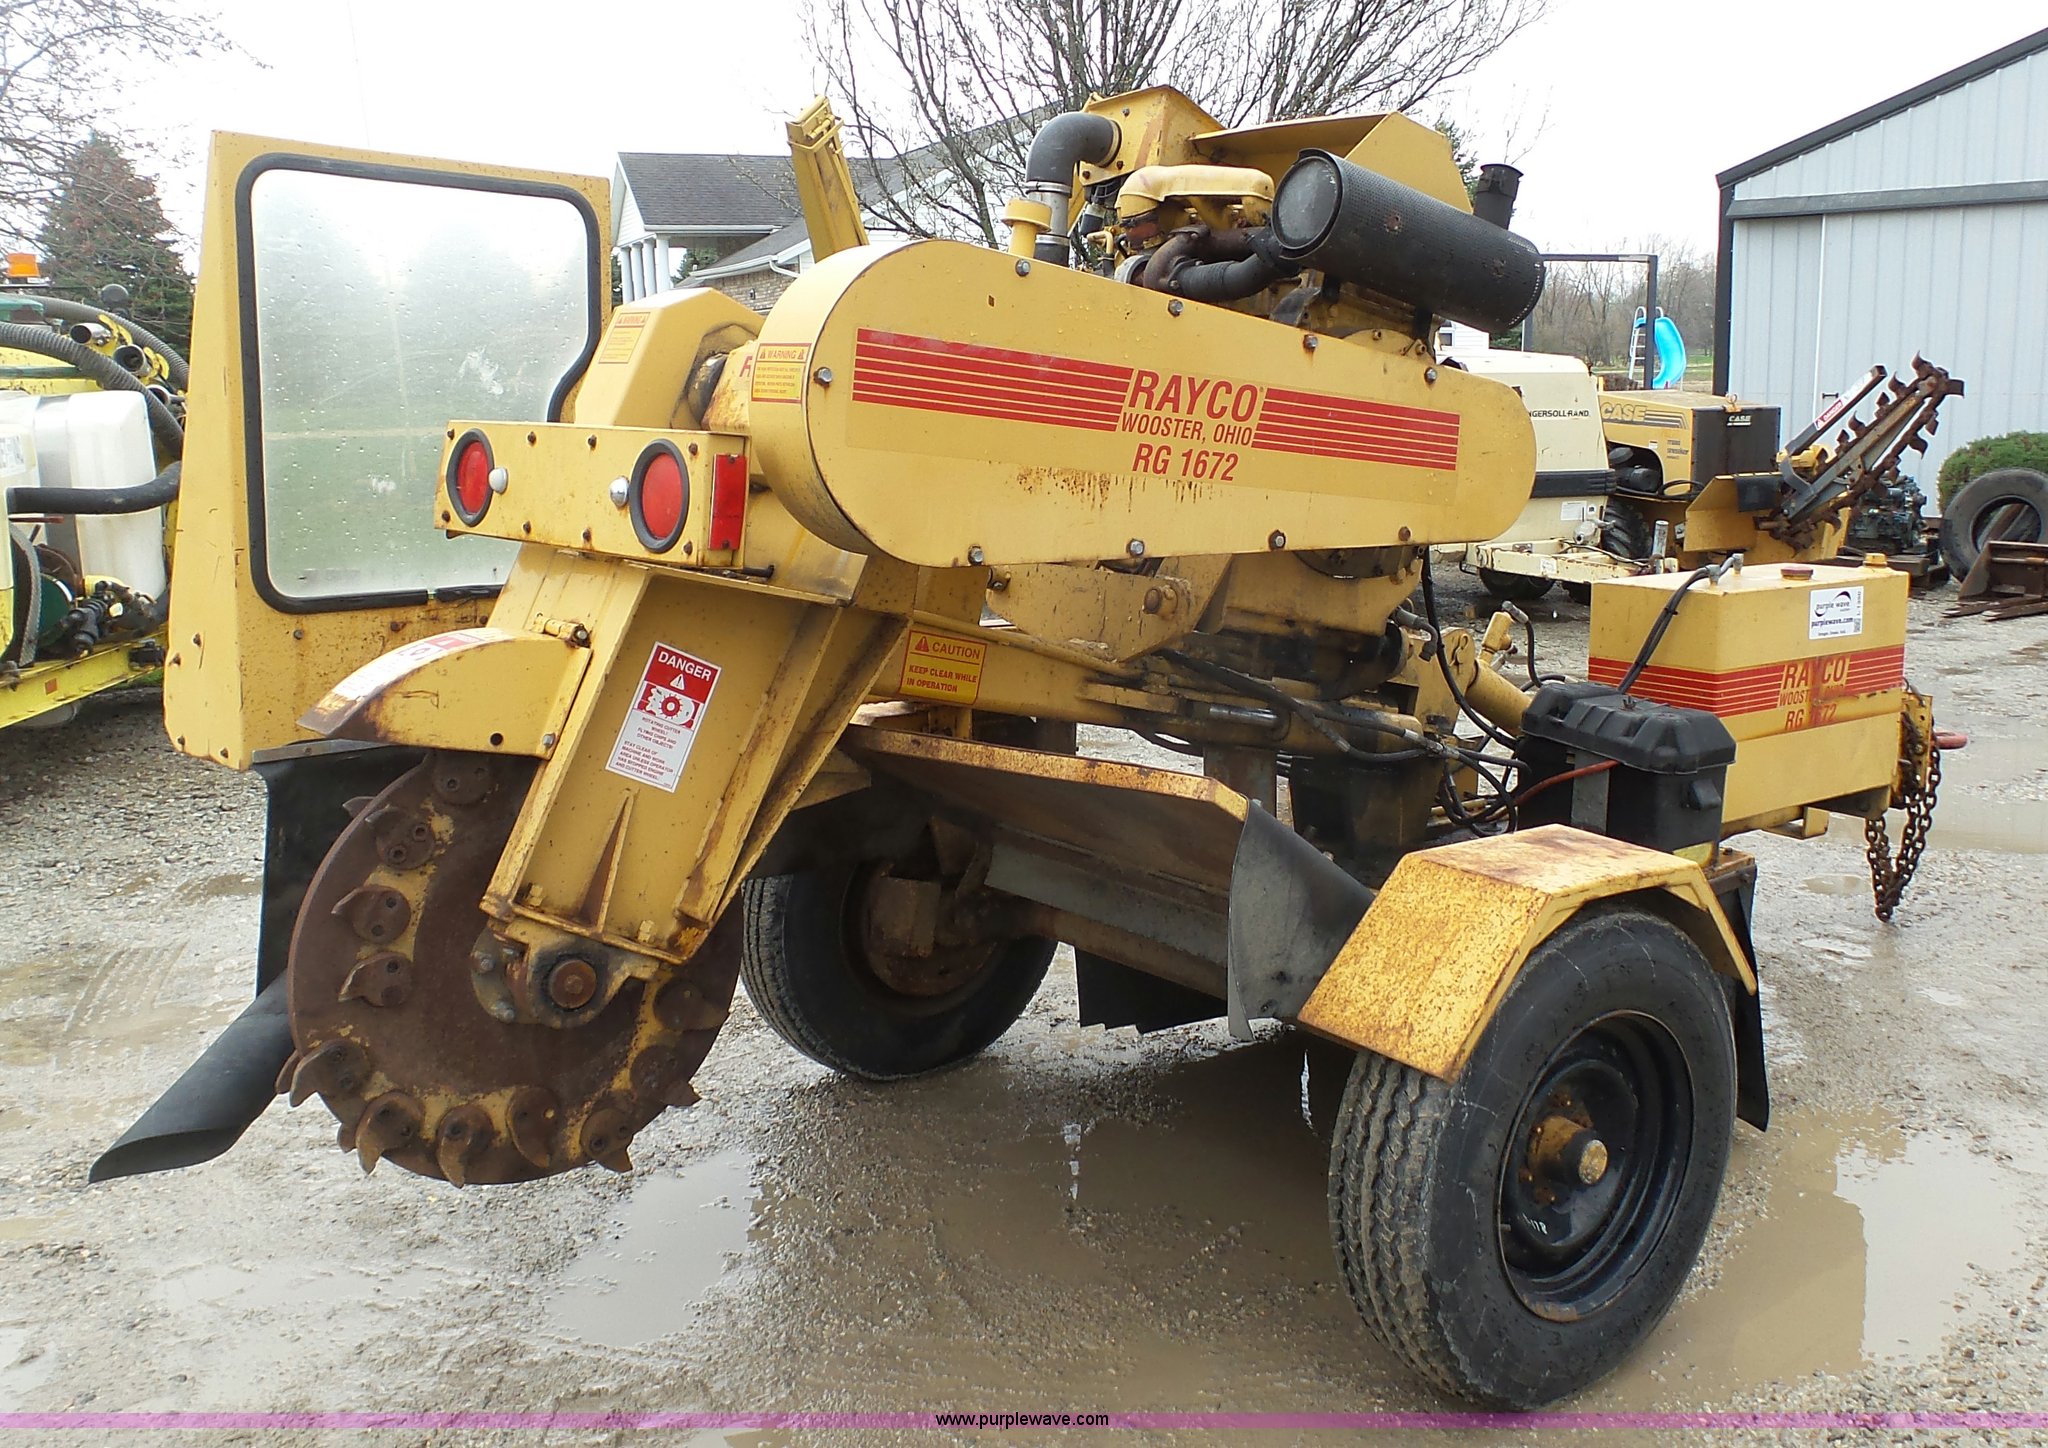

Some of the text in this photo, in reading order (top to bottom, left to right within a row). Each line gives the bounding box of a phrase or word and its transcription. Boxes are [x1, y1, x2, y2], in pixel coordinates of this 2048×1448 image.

[767, 350, 797, 360] WARNING
[1128, 369, 1258, 422] RAYCO
[1601, 402, 1648, 421] CASE
[1121, 412, 1253, 446] WOOSTER, OHIO
[1132, 443, 1239, 482] RG 1672
[932, 642, 980, 660] CAUTION
[658, 651, 712, 682] DANGER
[909, 664, 977, 683] KEEP CLEAR WHILE
[906, 677, 958, 692] IN OPERATION
[1785, 708, 1804, 730] RG
